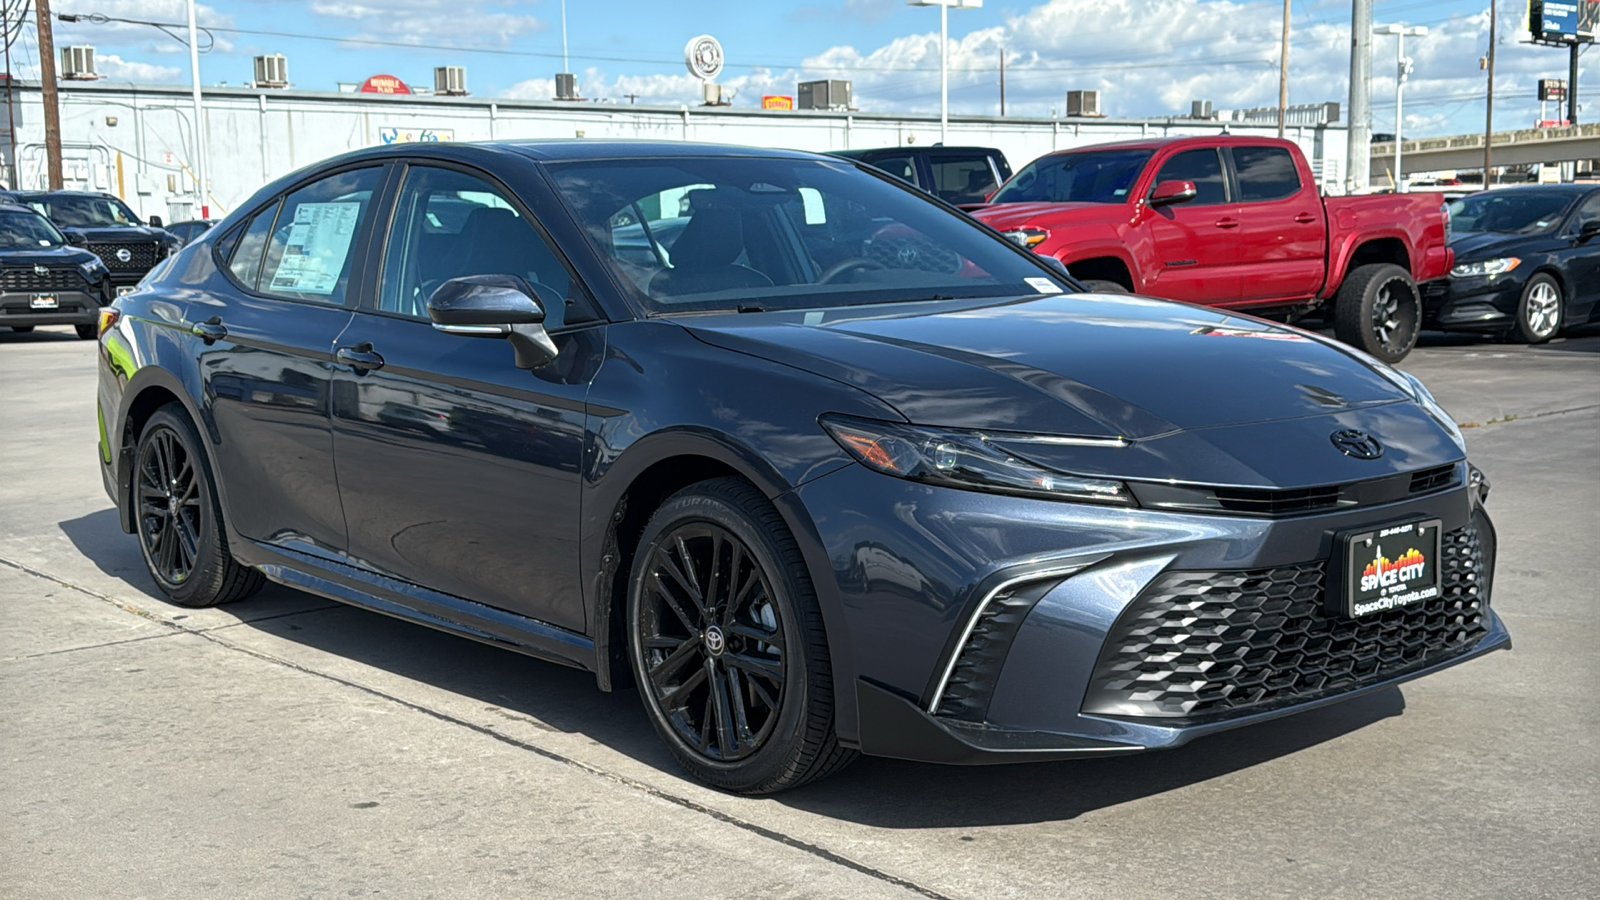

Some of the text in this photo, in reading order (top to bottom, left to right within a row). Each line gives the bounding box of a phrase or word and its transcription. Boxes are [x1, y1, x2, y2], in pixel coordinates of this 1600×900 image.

[1361, 562, 1425, 591] SPACE CITY
[1388, 583, 1407, 593] TOYOTA
[1354, 587, 1437, 615] SpaceCityToyota.com
